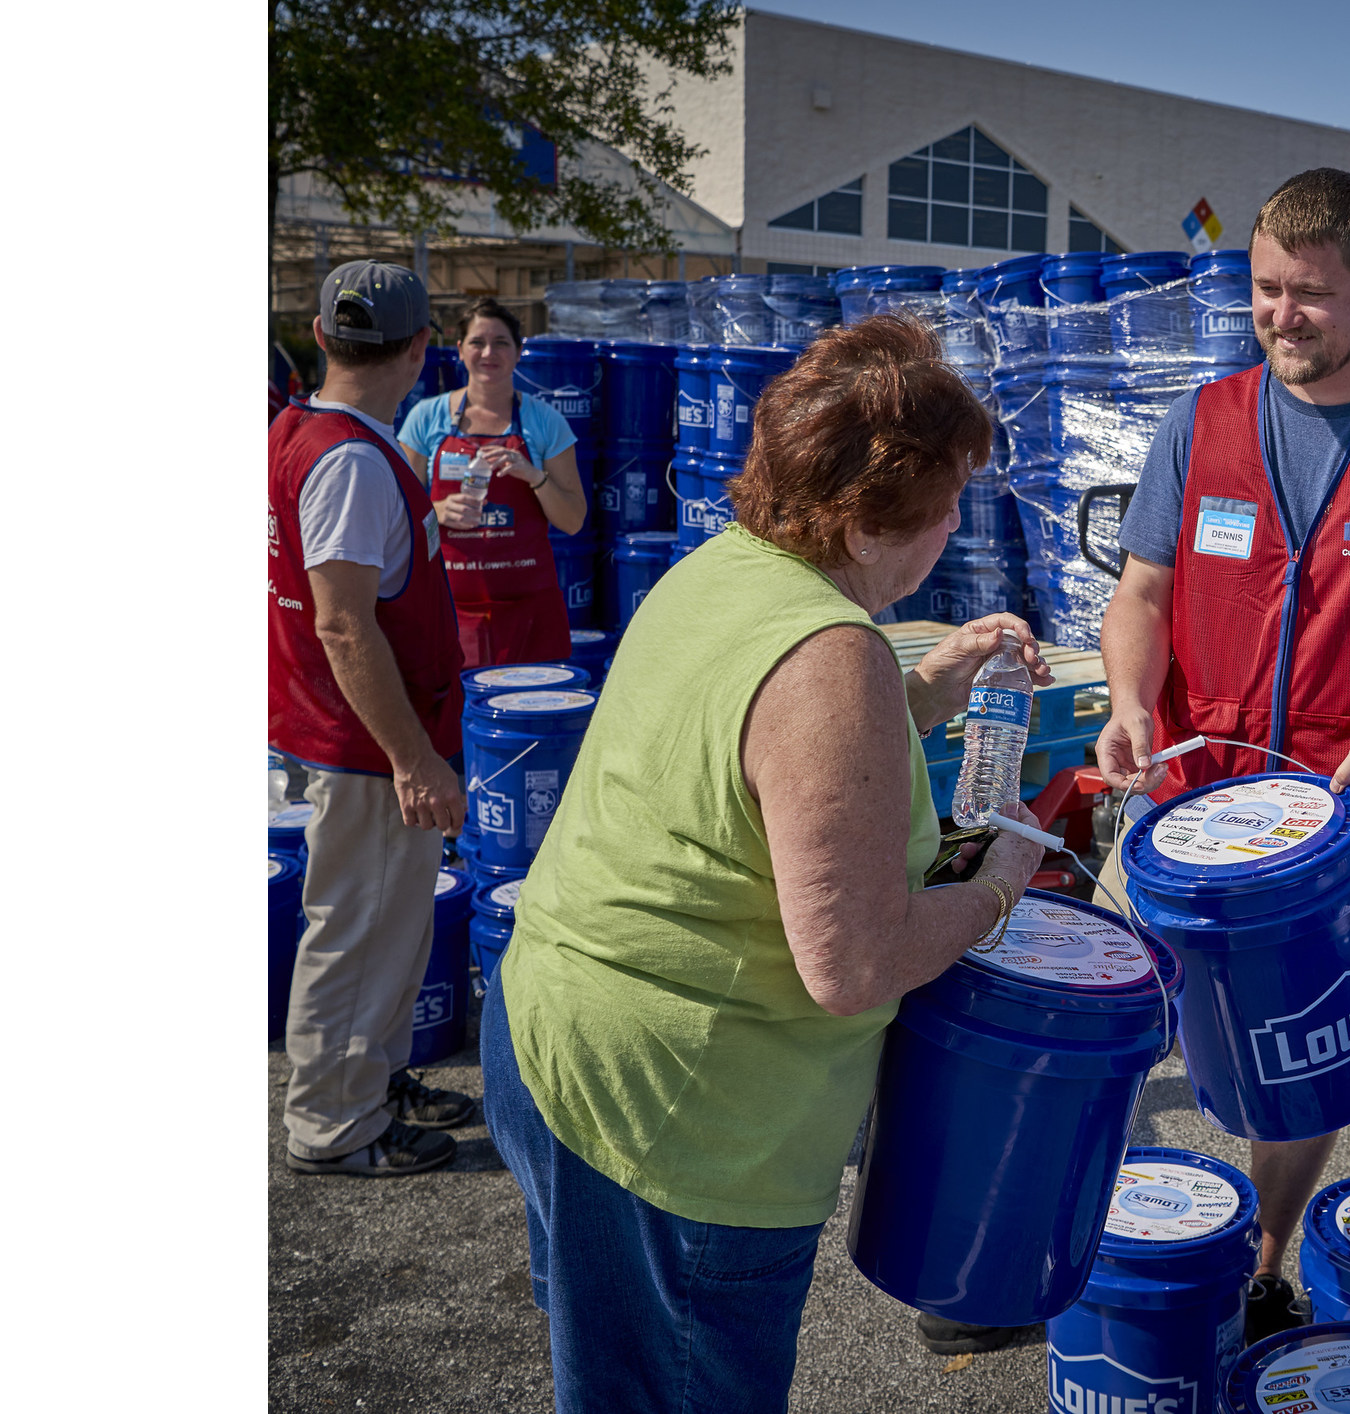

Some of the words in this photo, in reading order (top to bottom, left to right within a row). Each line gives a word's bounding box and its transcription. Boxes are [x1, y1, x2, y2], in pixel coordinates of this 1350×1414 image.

[543, 398, 590, 413] OWE'S
[485, 530, 515, 538] Service
[1211, 529, 1243, 542] DENNIS
[453, 562, 465, 570] us
[466, 561, 477, 570] at
[478, 558, 536, 570] Lowes.com
[1218, 814, 1265, 828] LOWE'S
[1287, 818, 1320, 828] GLAD
[1000, 956, 1042, 965] Cutter
[1133, 1193, 1180, 1210] LOWE'S
[1197, 1201, 1233, 1209] Fabuloso
[1267, 1375, 1307, 1391] Quickie
